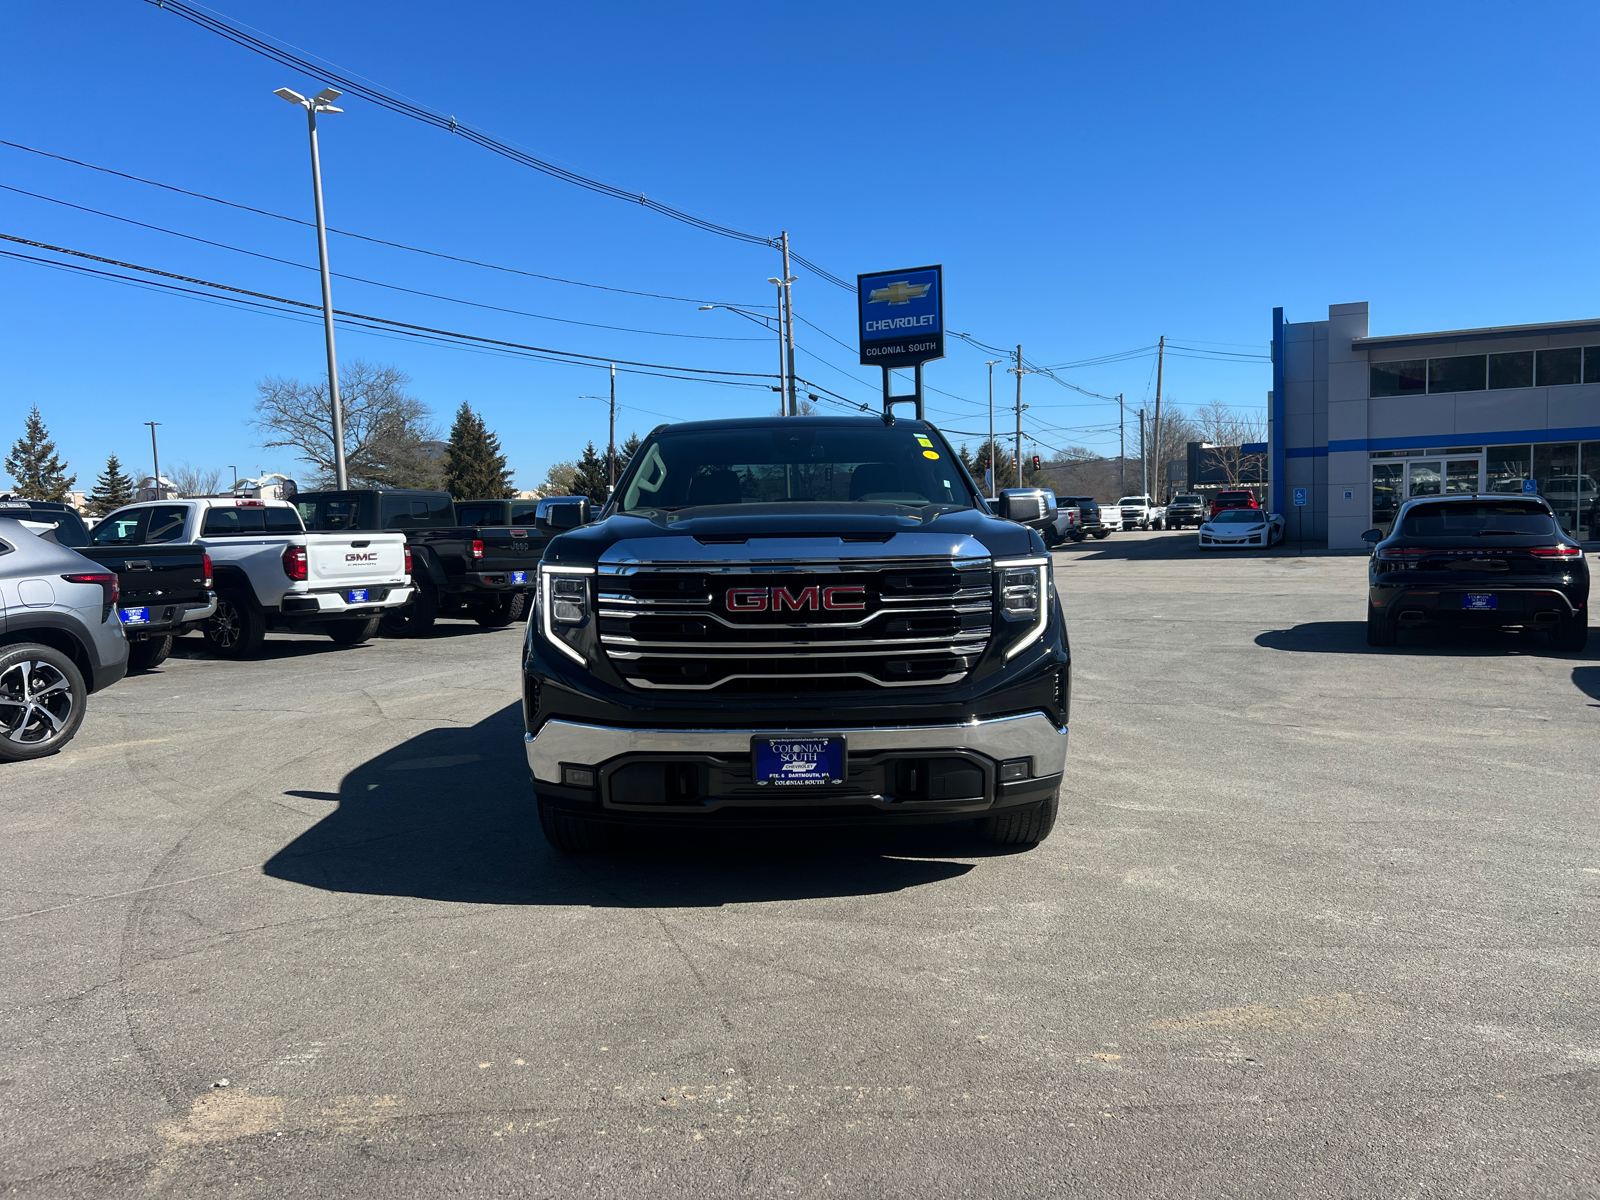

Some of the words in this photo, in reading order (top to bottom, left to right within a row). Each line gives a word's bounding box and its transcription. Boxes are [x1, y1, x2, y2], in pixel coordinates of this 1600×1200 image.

[866, 314, 934, 331] CHEVROLET
[866, 345, 906, 356] COLONIAL
[908, 342, 936, 352] SOUTH
[510, 541, 529, 551] Jeep
[345, 552, 377, 562] GMC
[725, 586, 866, 612] GMC
[772, 744, 825, 753] COLONIAL
[780, 753, 817, 761] SOUTH
